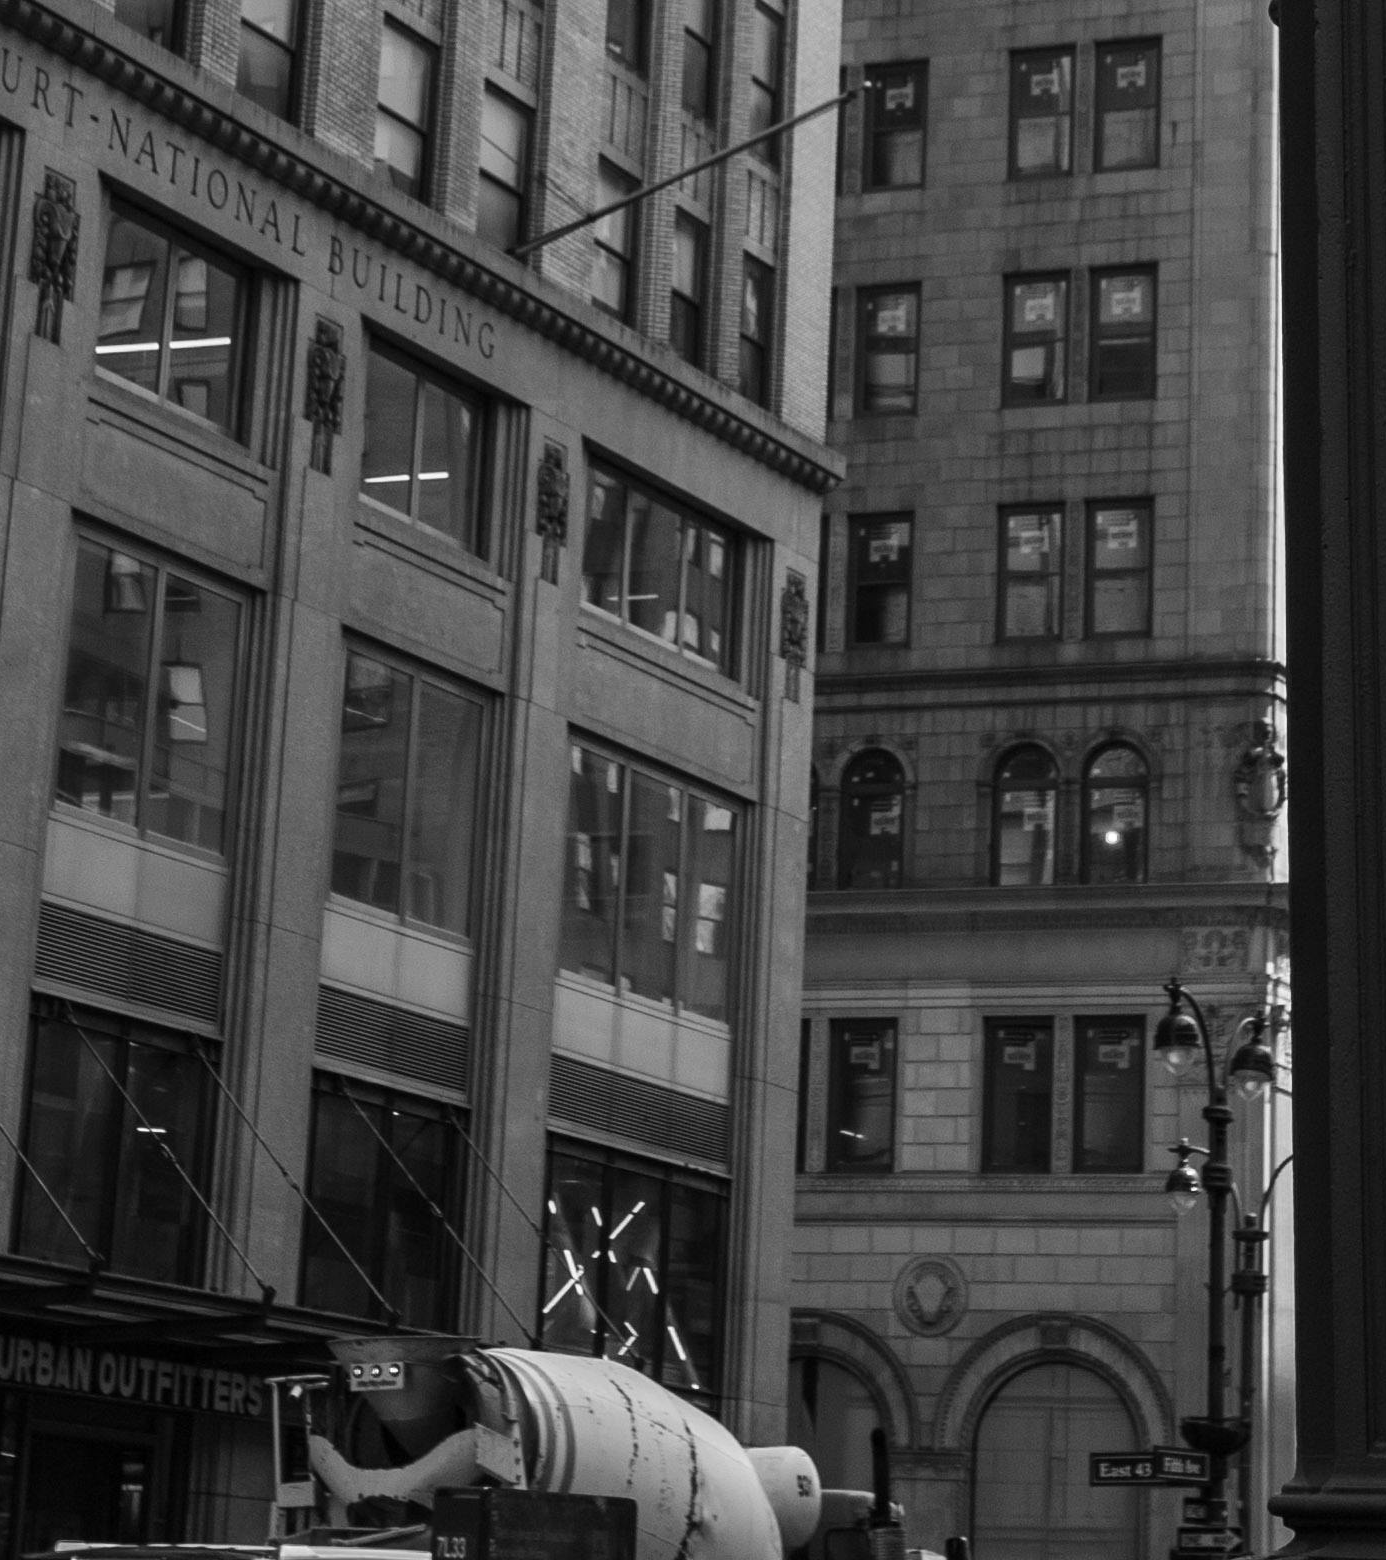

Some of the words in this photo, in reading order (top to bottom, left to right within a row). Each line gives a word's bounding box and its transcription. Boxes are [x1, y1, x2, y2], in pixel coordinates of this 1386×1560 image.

[327, 235, 496, 360] BUILDING
[98, 1352, 263, 1416] OUTFITTERS
[1099, 1463, 1131, 1478] East
[1134, 1462, 1153, 1477] 43
